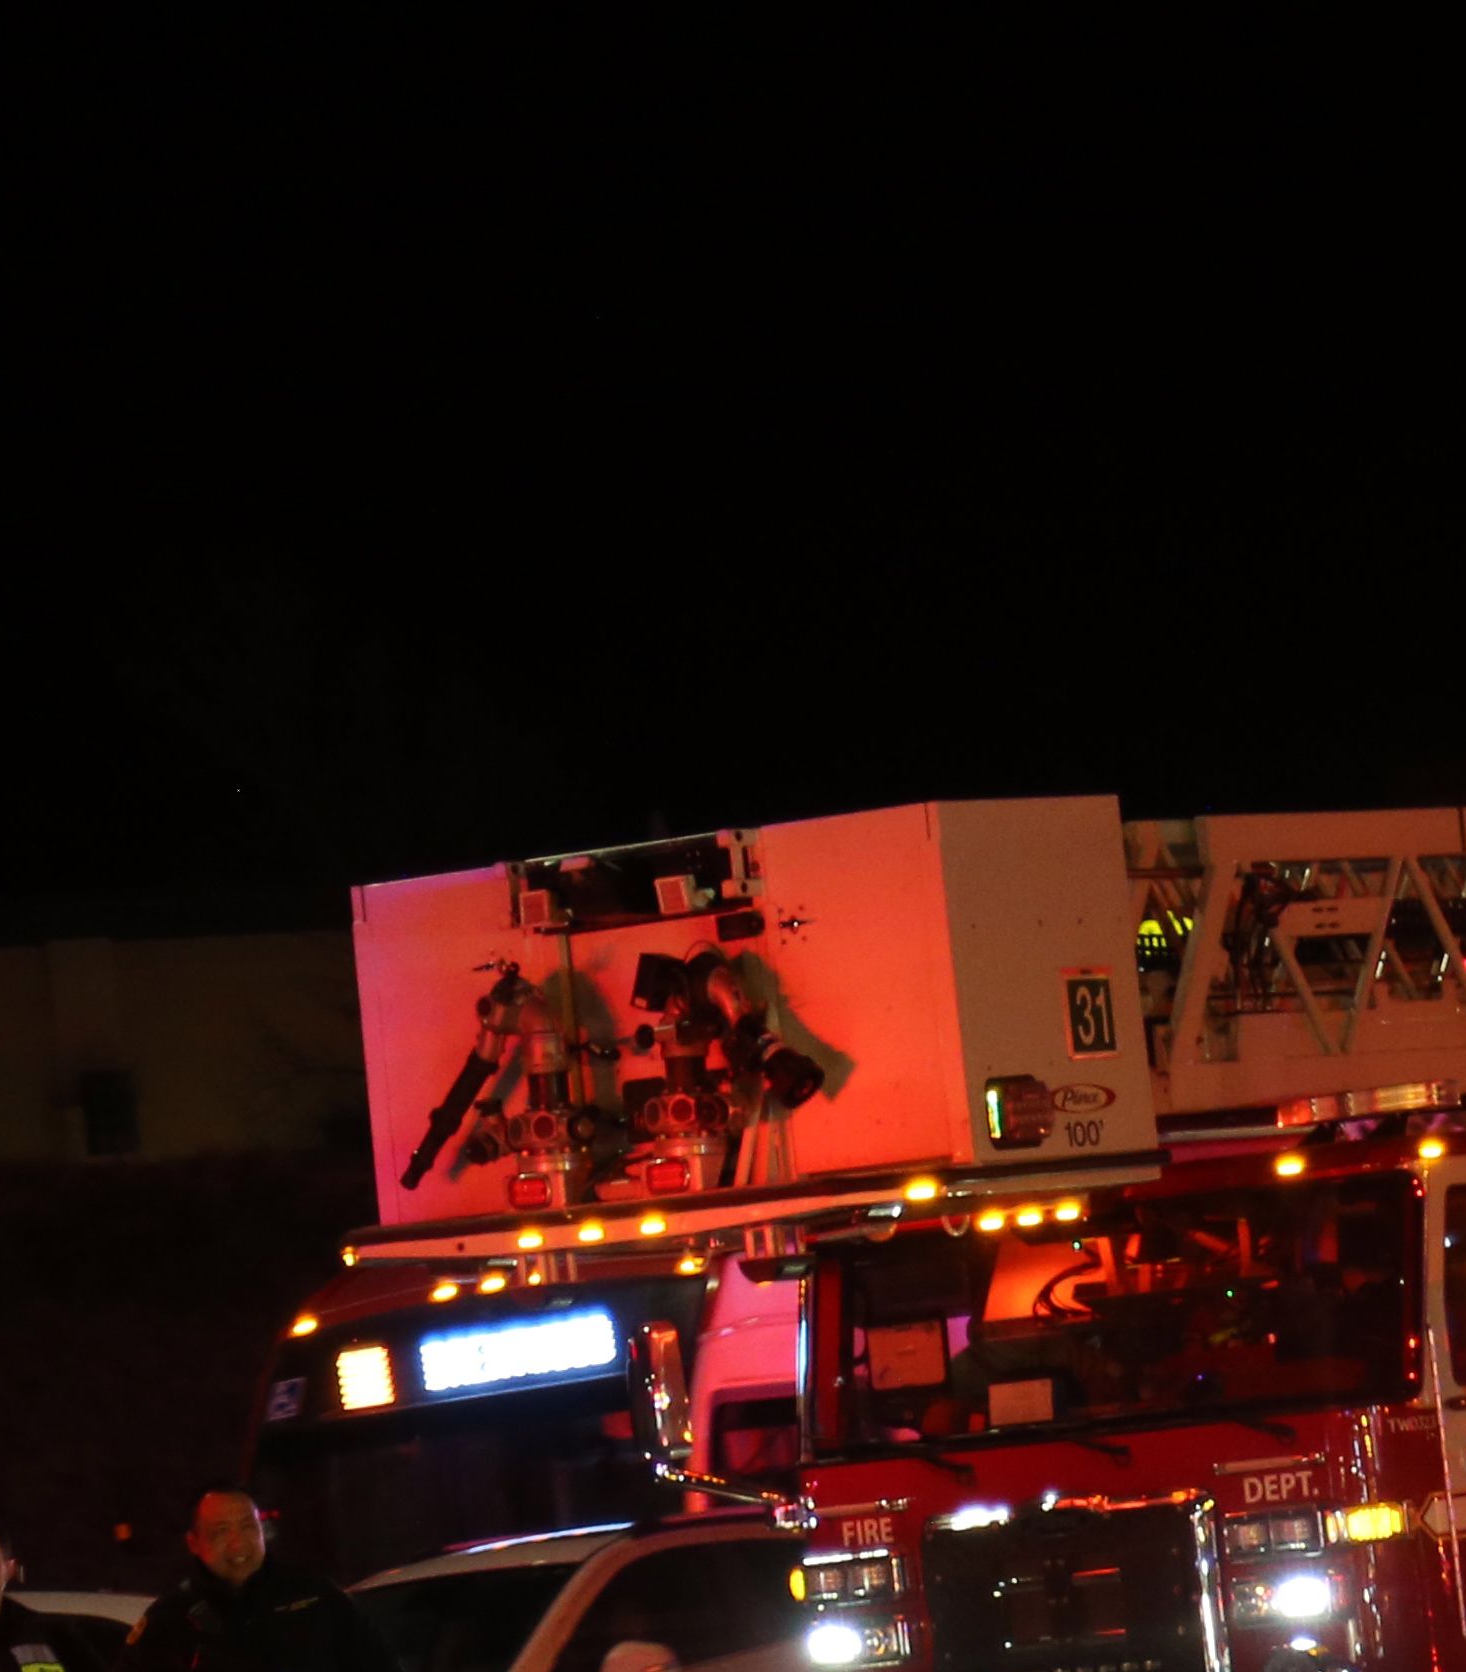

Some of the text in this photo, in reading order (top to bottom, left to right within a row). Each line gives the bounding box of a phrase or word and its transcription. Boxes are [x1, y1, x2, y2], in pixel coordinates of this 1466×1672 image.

[1076, 984, 1110, 1046] 31
[1242, 1470, 1320, 1504] DEPT.
[840, 1515, 895, 1547] FIRE
